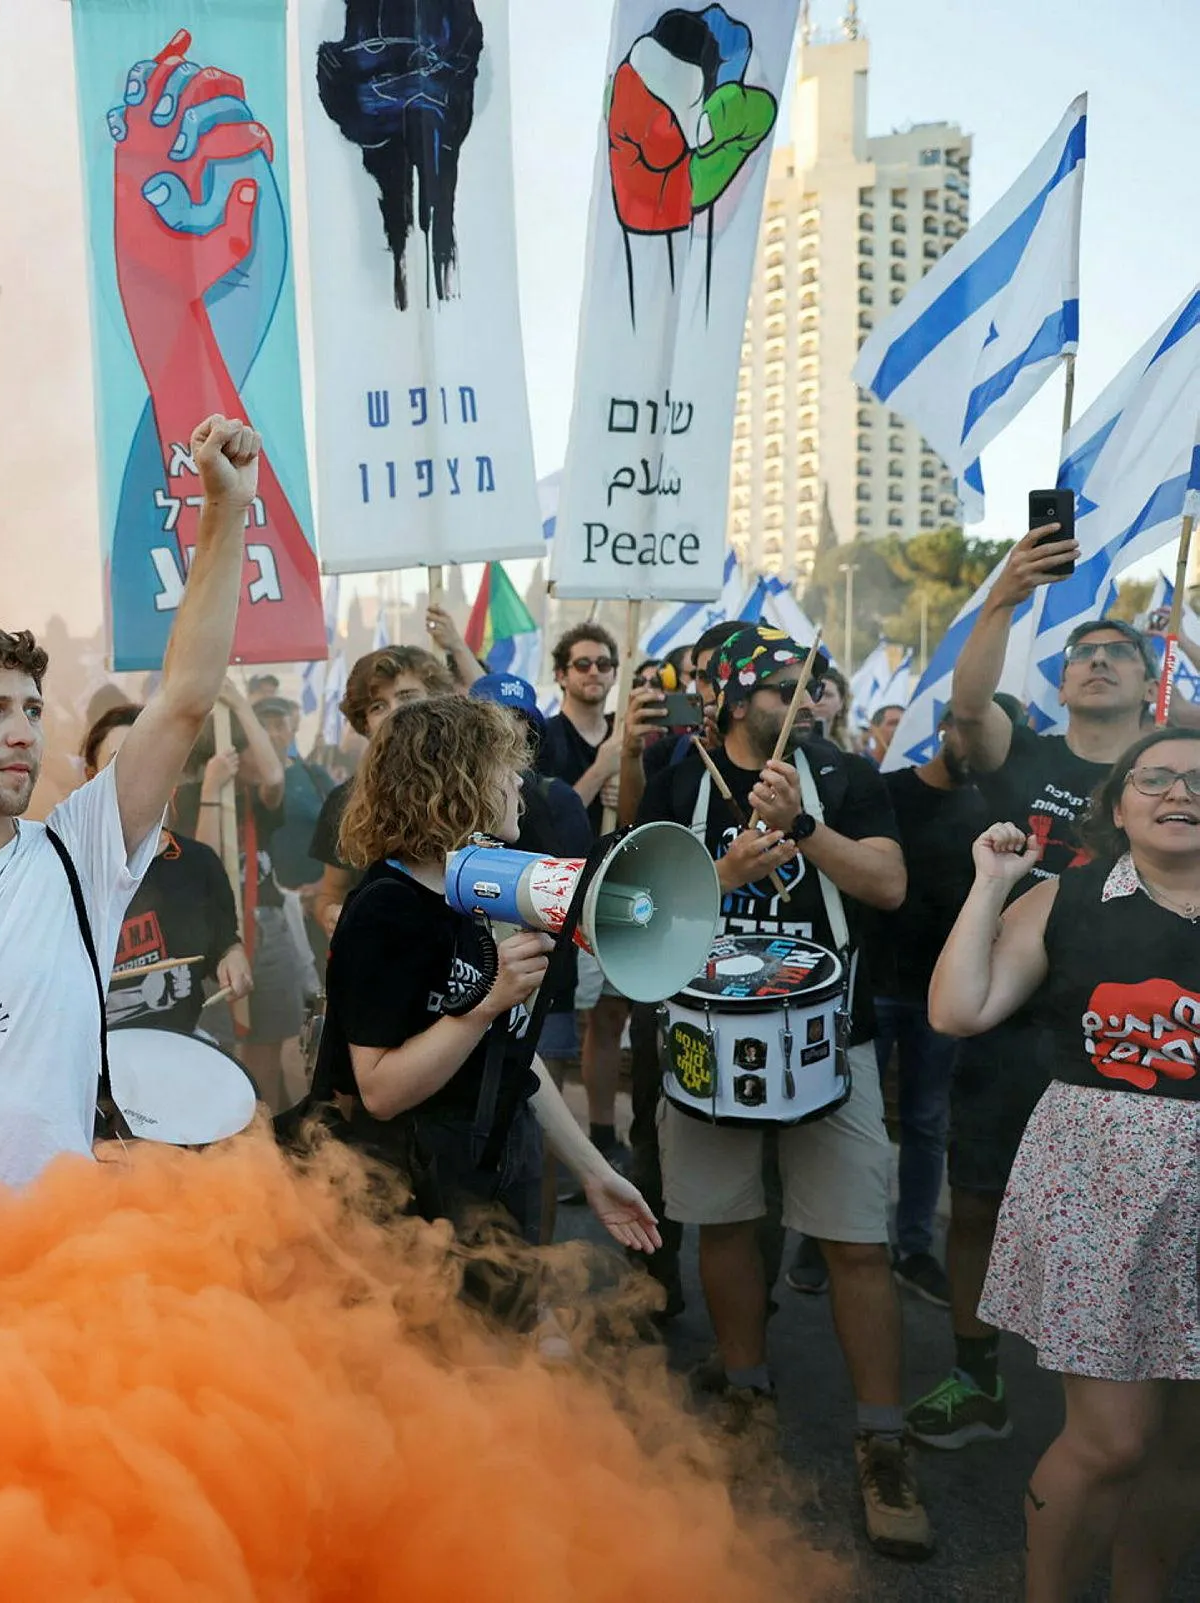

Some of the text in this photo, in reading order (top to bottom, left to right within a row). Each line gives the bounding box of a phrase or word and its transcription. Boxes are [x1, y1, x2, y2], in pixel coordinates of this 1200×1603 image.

[367, 386, 477, 427] חופש
[608, 389, 693, 435] שלום
[359, 456, 495, 503] מצפון
[607, 452, 681, 507] سلام
[155, 489, 267, 532] הדל
[583, 522, 700, 566] Peace
[150, 545, 283, 611] גע
